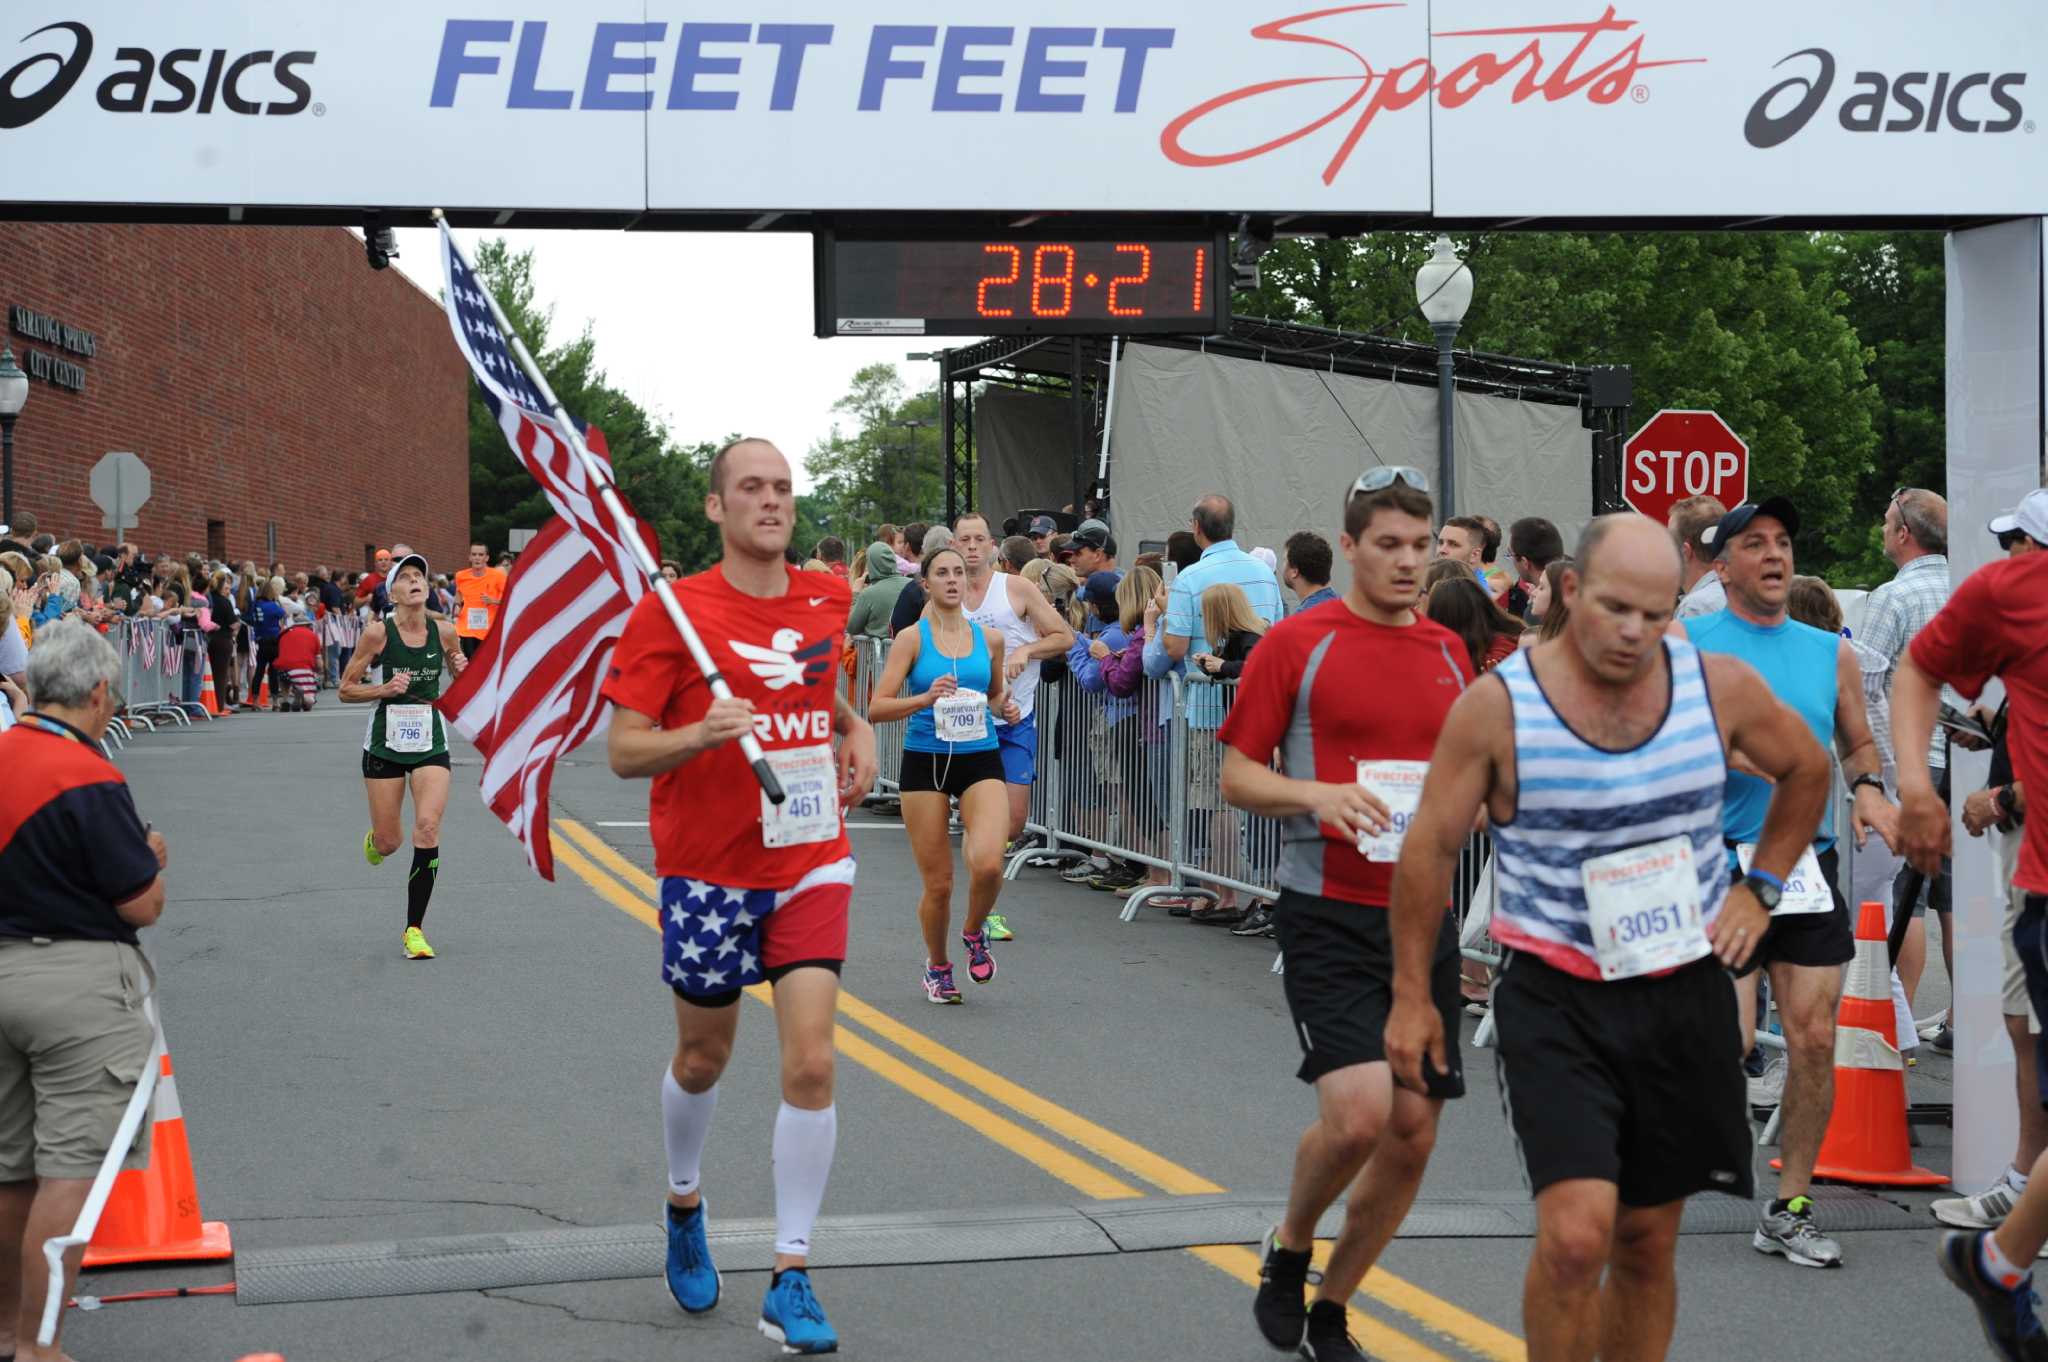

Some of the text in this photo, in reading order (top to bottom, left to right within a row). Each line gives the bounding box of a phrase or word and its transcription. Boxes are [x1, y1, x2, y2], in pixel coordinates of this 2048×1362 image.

[96, 47, 317, 116] asics
[429, 2, 1708, 187] FLEET FEET Sports
[1838, 71, 2027, 133] asics
[16, 304, 61, 347] SARATOGA
[31, 349, 86, 392] CITY CENTER
[1631, 450, 1739, 496] STOP
[400, 728, 421, 740] 796
[751, 710, 830, 742] RWB
[950, 713, 975, 728] 709
[787, 780, 823, 795] MILTON
[788, 794, 821, 818] 461
[1618, 902, 1682, 943] 3051
